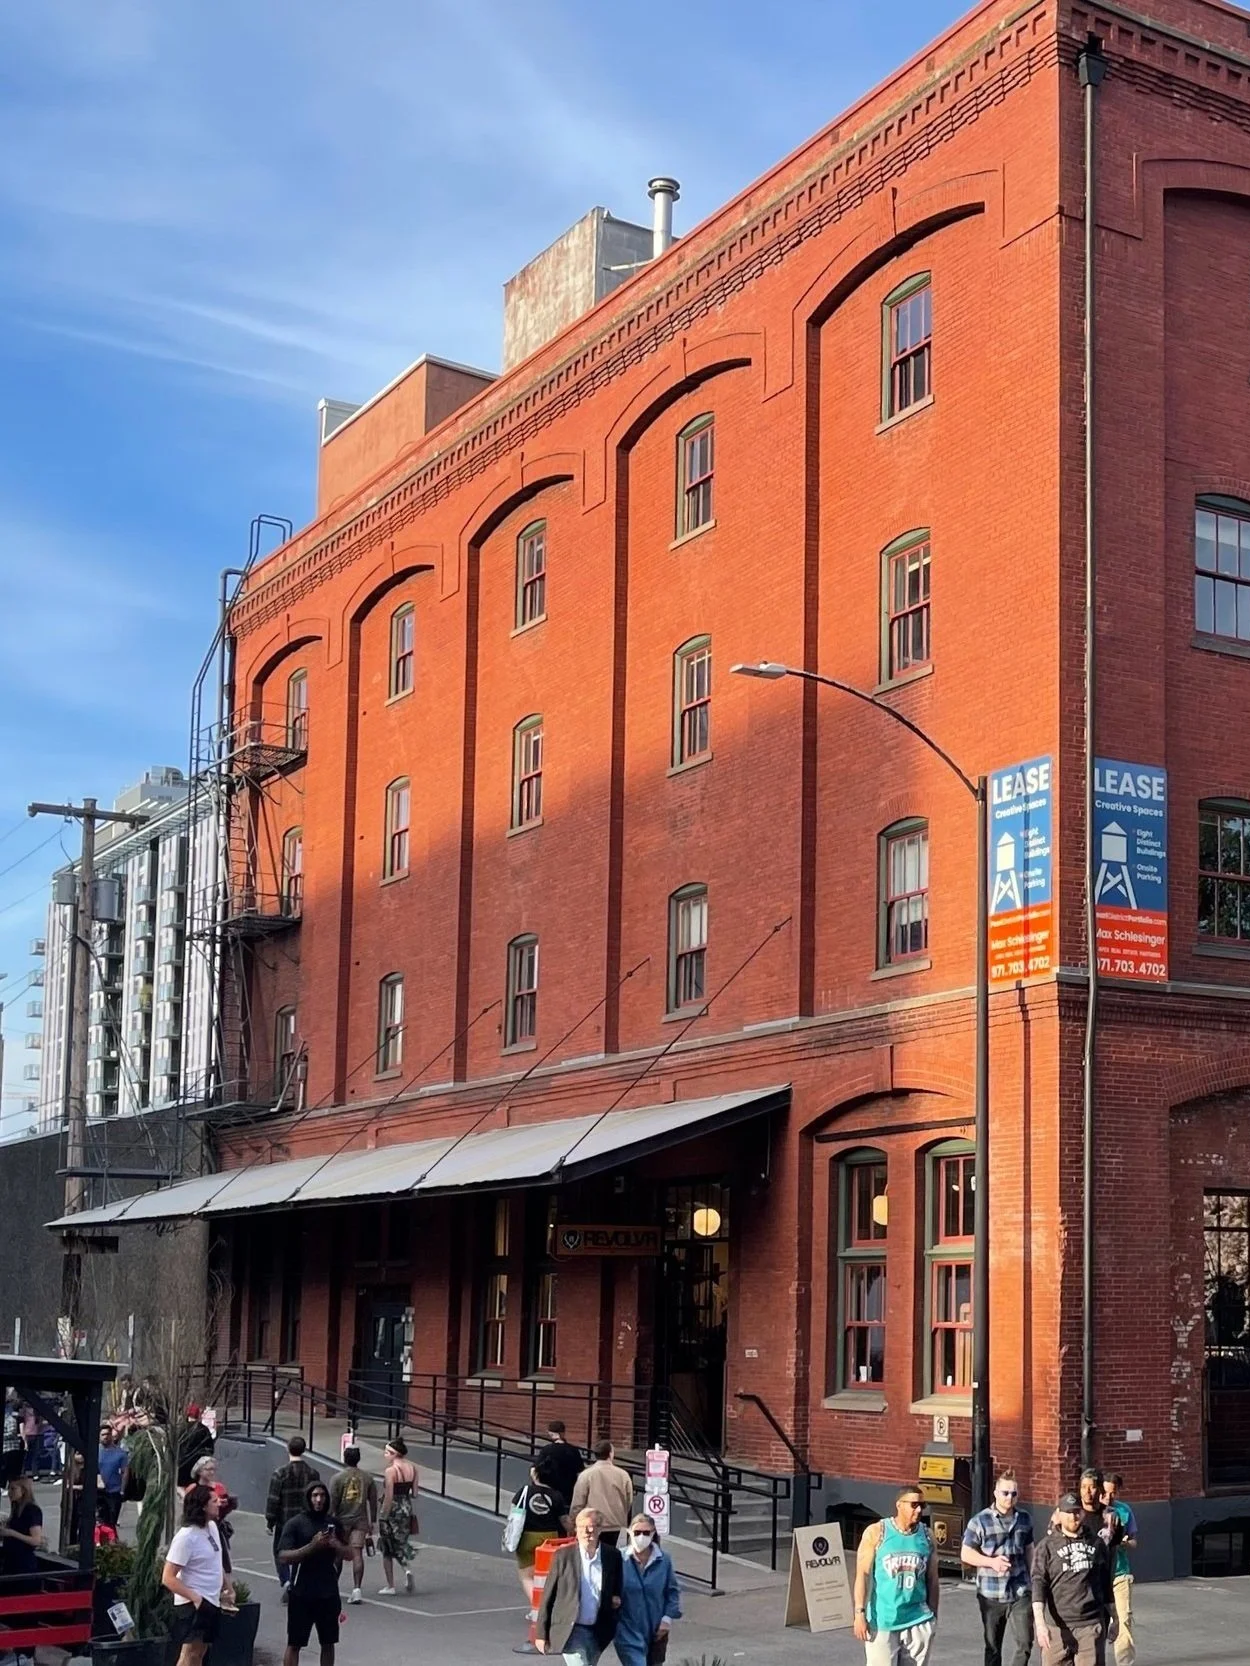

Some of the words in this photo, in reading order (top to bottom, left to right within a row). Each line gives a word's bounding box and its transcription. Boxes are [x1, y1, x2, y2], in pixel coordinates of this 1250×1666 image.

[993, 763, 1049, 805] LEASE
[1094, 767, 1165, 801] LEASE
[995, 805, 1022, 819] Creative
[1023, 798, 1047, 813] Spaces
[1095, 800, 1132, 813] Creative
[1133, 804, 1164, 818] Spaces
[1136, 828, 1152, 839] Eight
[1136, 838, 1161, 848] Distinct
[1136, 847, 1166, 859] Buildings
[1136, 863, 1158, 873] Onsite
[1136, 873, 1162, 885] Parking
[1114, 930, 1166, 948] Schlesinger
[584, 1230, 657, 1248] REVOLVR
[805, 1556, 841, 1570] REVOLVR
[897, 1573, 915, 1590] 10
